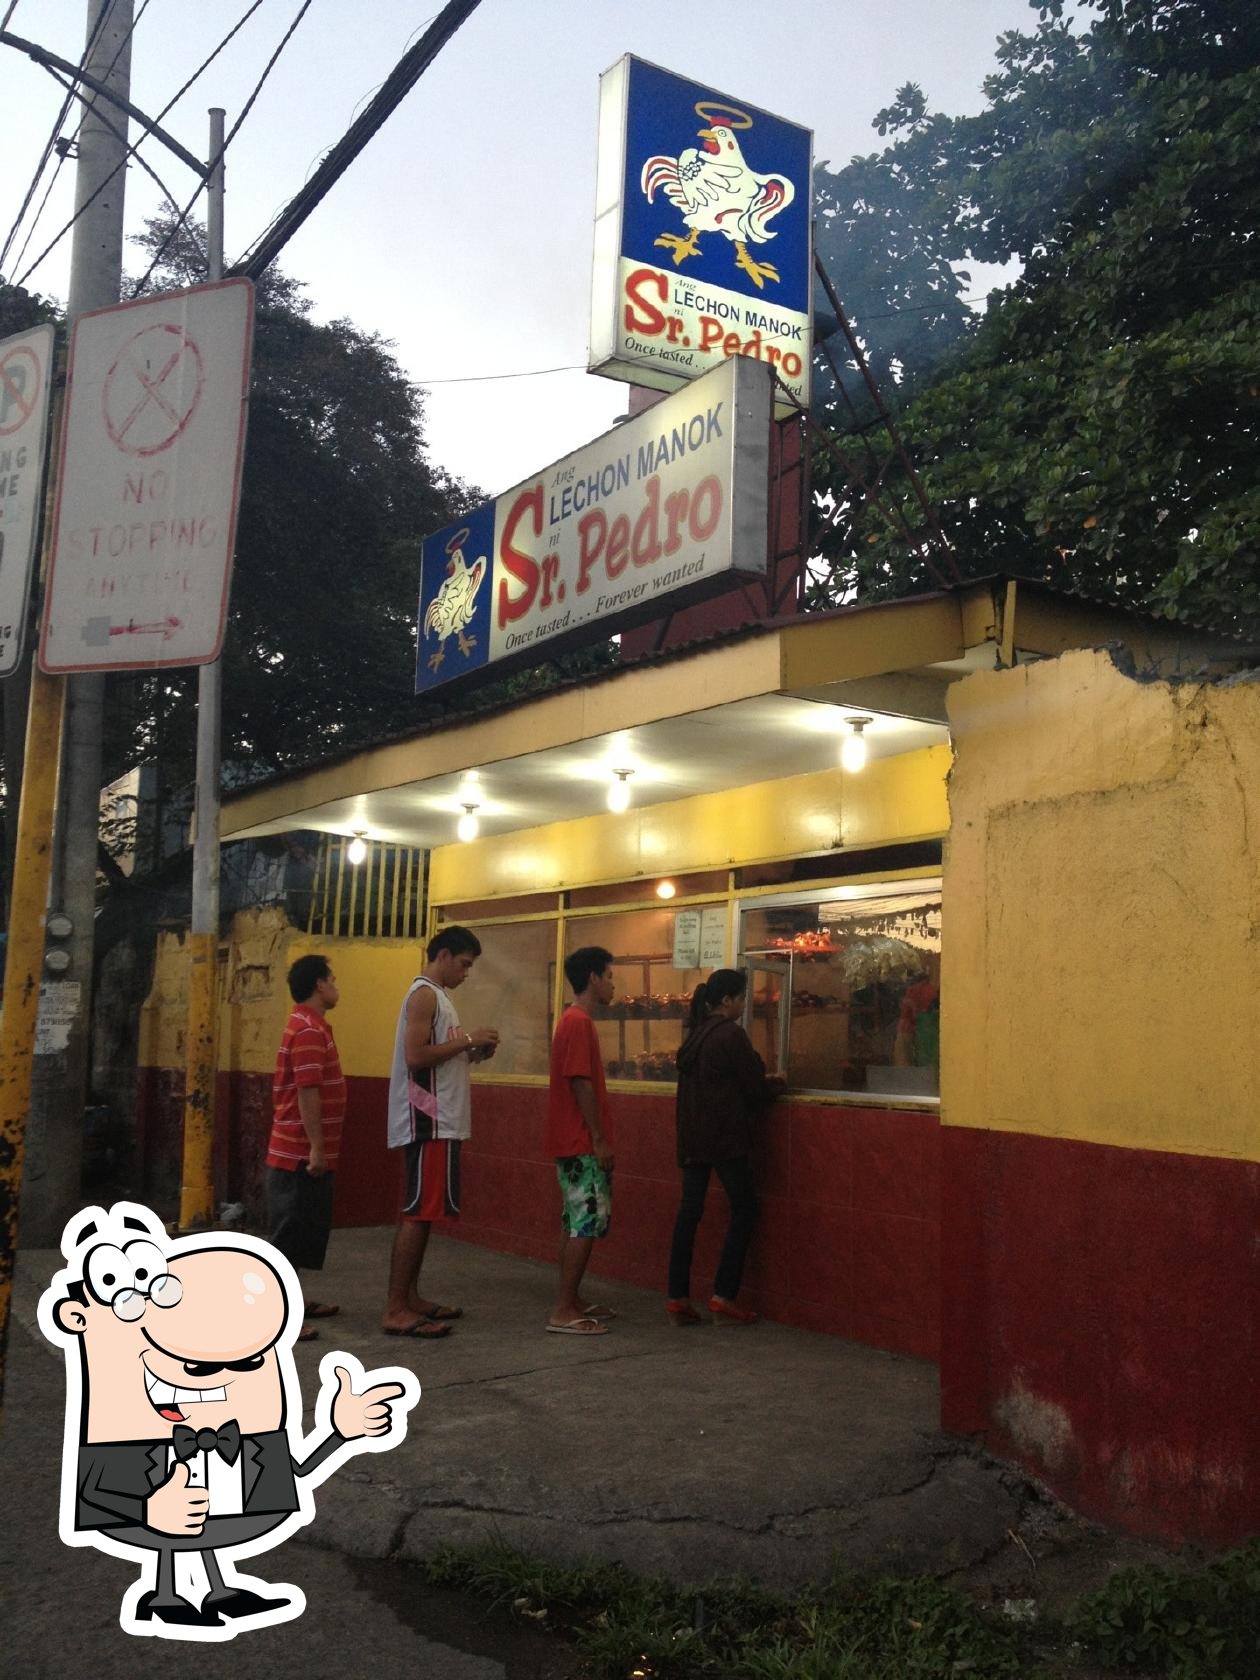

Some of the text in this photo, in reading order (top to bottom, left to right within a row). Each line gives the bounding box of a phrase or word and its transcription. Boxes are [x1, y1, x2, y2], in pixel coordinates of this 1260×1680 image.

[675, 279, 697, 292] Ang
[624, 268, 803, 378] Sr. Pedro
[674, 289, 802, 341] LECHON MANOK
[625, 337, 657, 356] Once
[550, 402, 724, 525] LECHON MANOK
[552, 466, 575, 487] Ang
[124, 470, 168, 504] NO
[498, 474, 724, 631] Sr. Pedro
[549, 528, 560, 548] ni
[505, 626, 534, 650] Once
[596, 581, 648, 613] Forever
[652, 553, 705, 588] wanted
